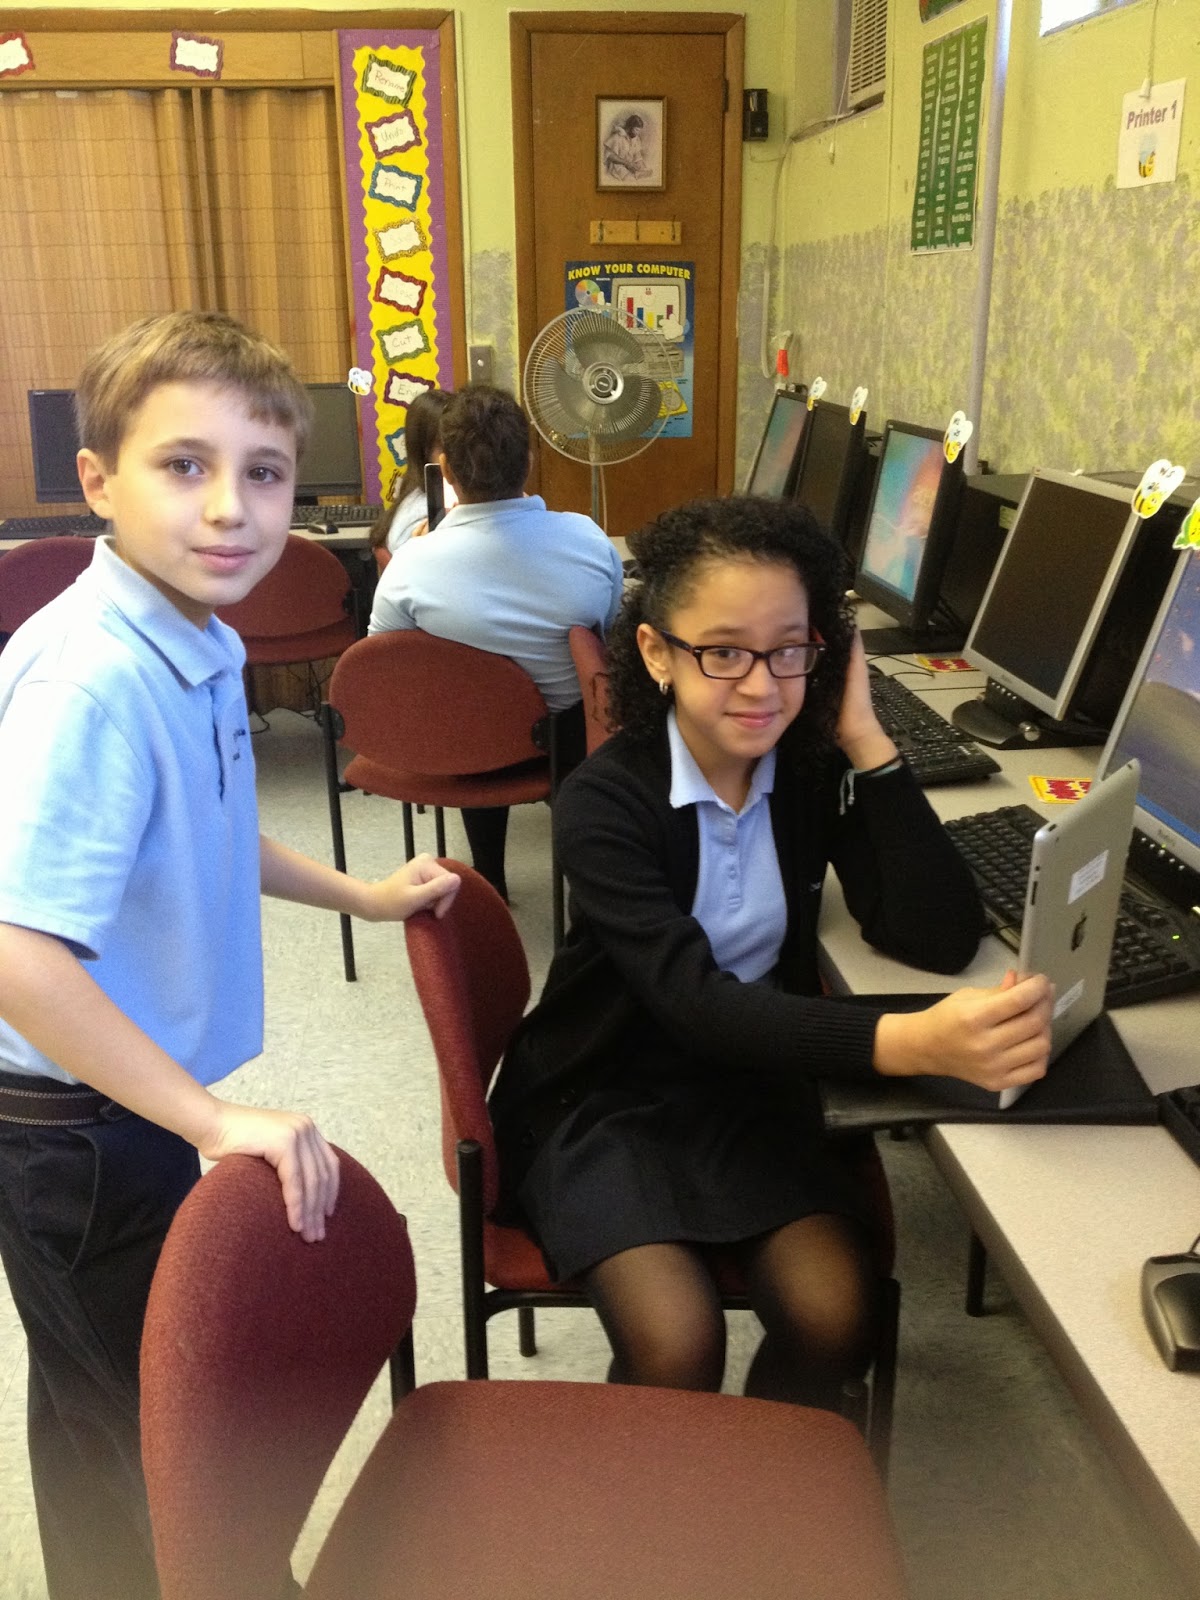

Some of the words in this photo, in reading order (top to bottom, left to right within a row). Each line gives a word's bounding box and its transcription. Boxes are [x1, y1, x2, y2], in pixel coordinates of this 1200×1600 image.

[1126, 106, 1168, 130] Printer
[1170, 99, 1178, 120] 1
[568, 265, 600, 280] KNOW
[604, 263, 633, 274] YOUR
[636, 263, 691, 280] COMPUTER
[392, 334, 412, 348] Cut
